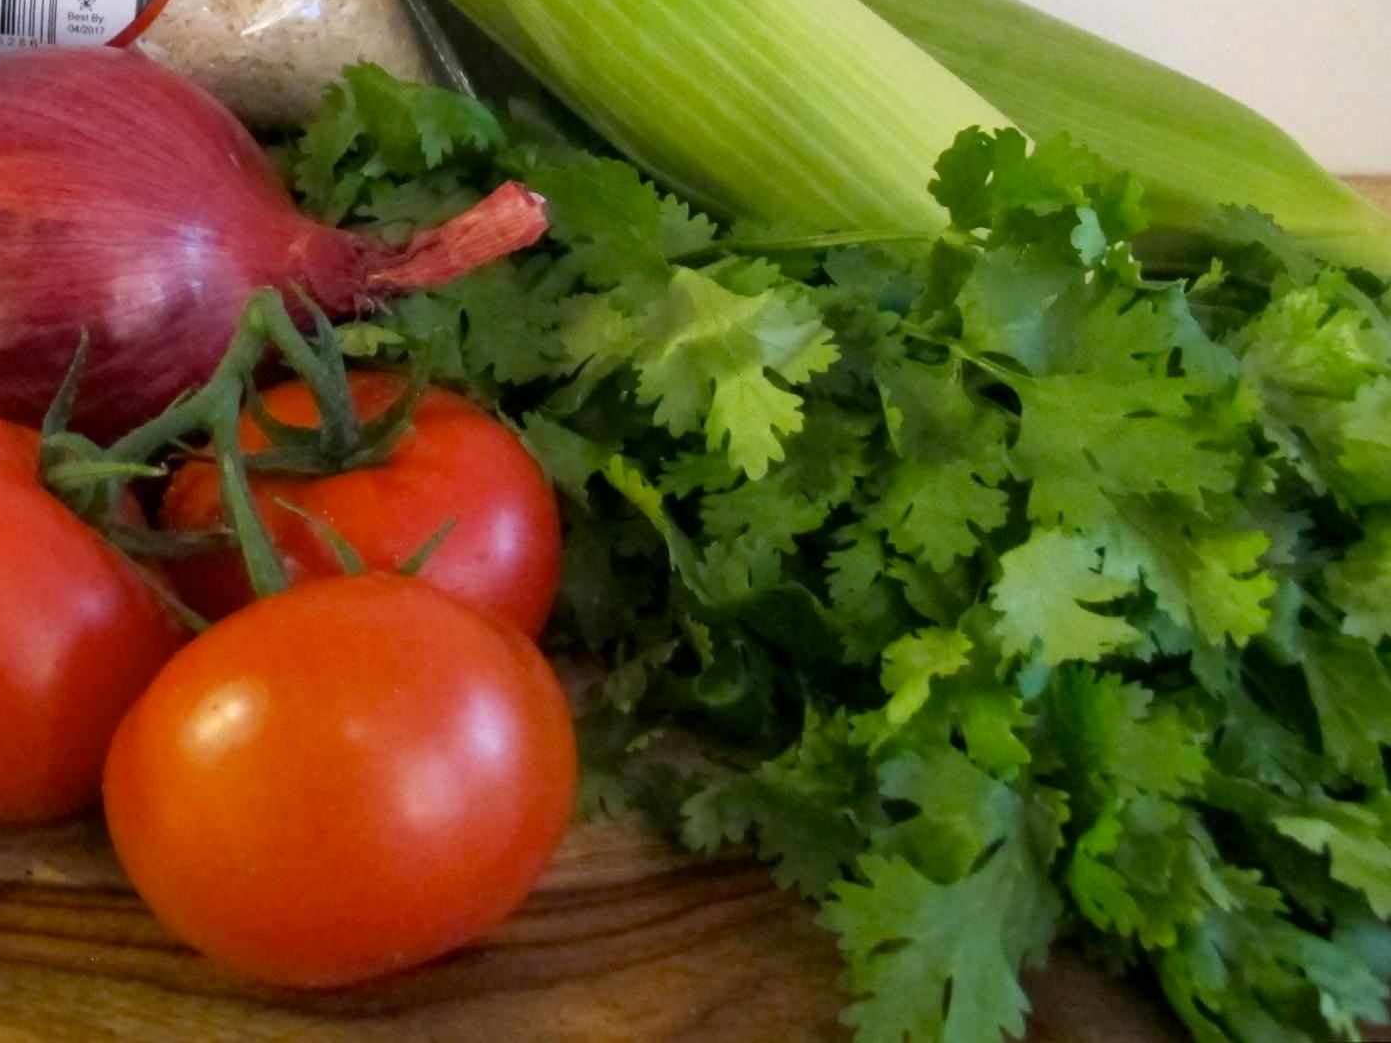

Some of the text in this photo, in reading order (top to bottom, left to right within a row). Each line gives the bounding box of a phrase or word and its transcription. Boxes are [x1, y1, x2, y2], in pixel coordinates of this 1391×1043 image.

[67, 11, 105, 24] Best By
[67, 24, 106, 35] 04/2017
